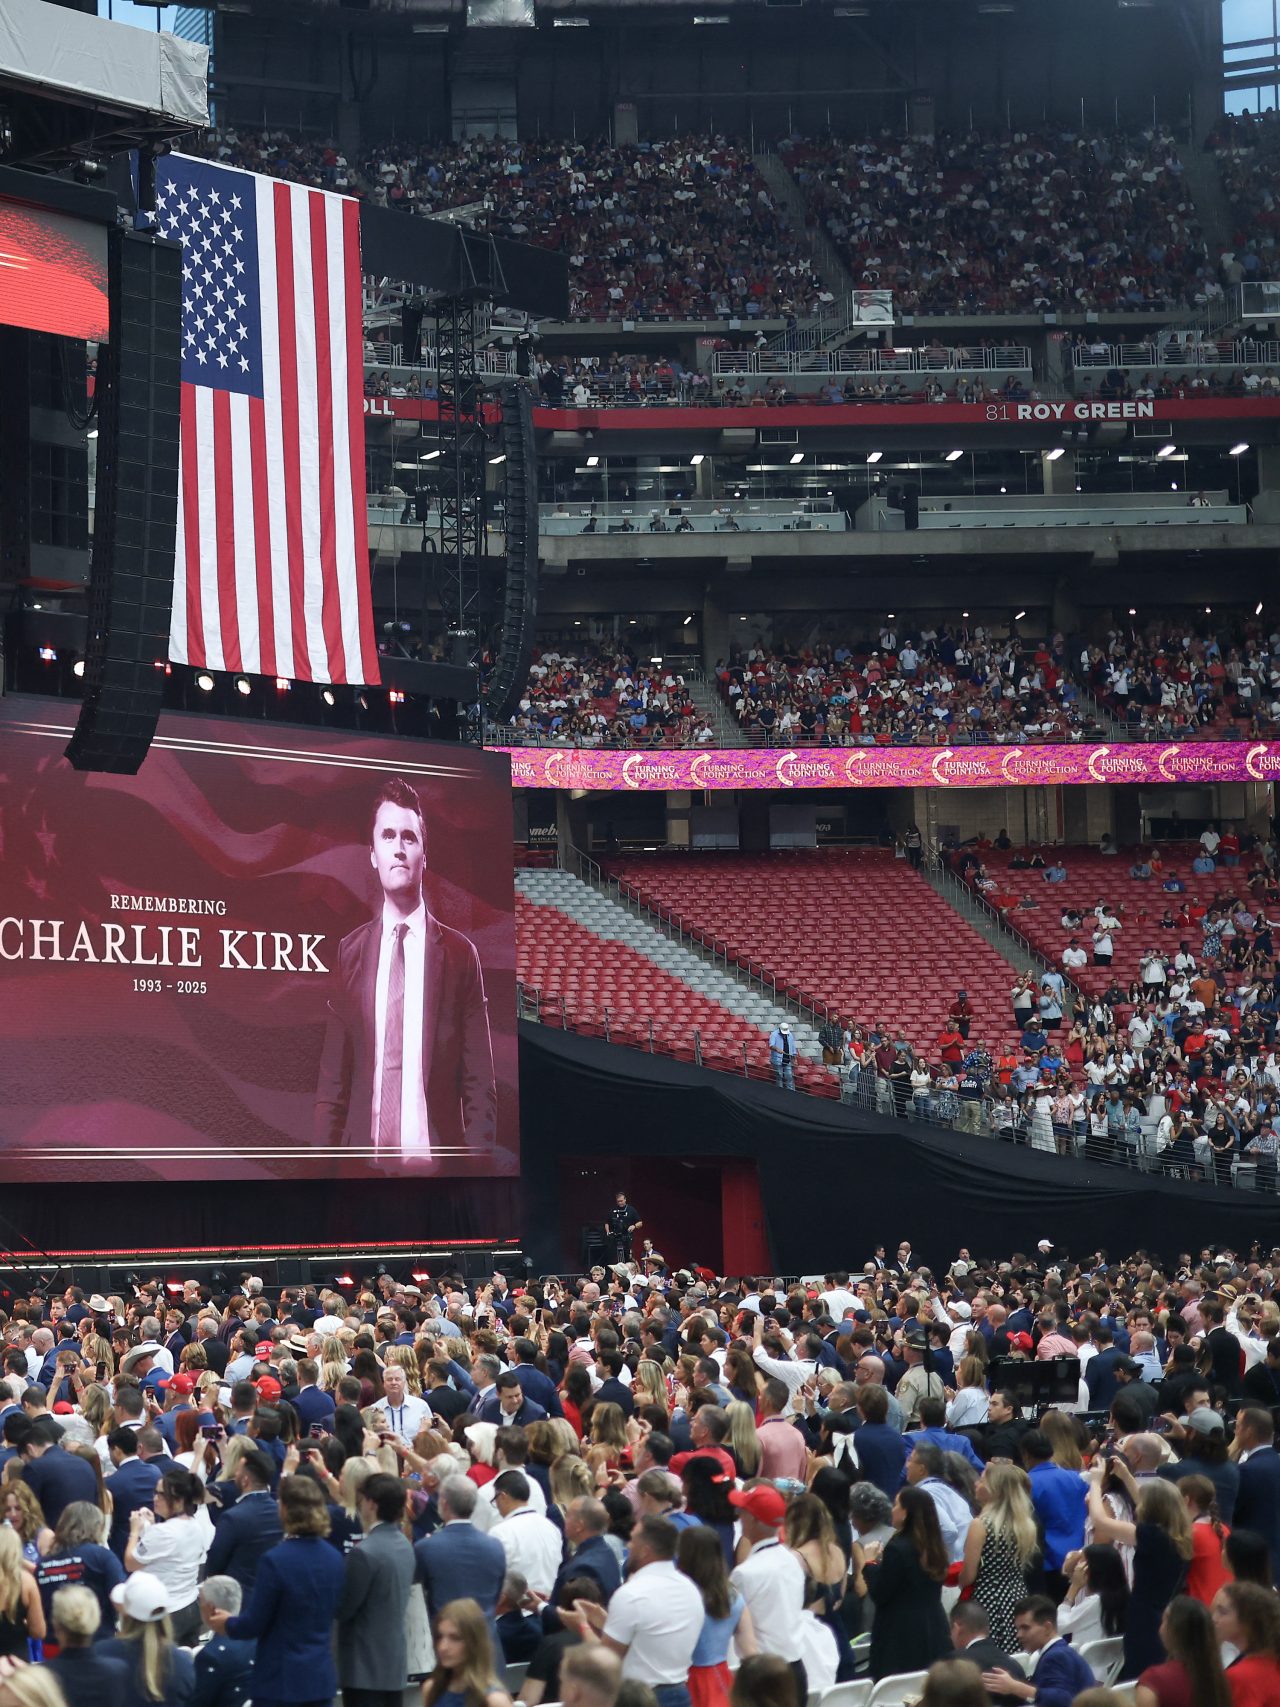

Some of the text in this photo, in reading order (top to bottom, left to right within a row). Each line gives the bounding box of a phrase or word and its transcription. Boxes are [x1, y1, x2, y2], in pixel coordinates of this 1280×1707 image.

[986, 402, 1154, 420] 81 ROY GREEN
[111, 894, 227, 916] REMEMBERING
[219, 929, 329, 972] KIRK
[133, 979, 207, 994] 1993 2025
